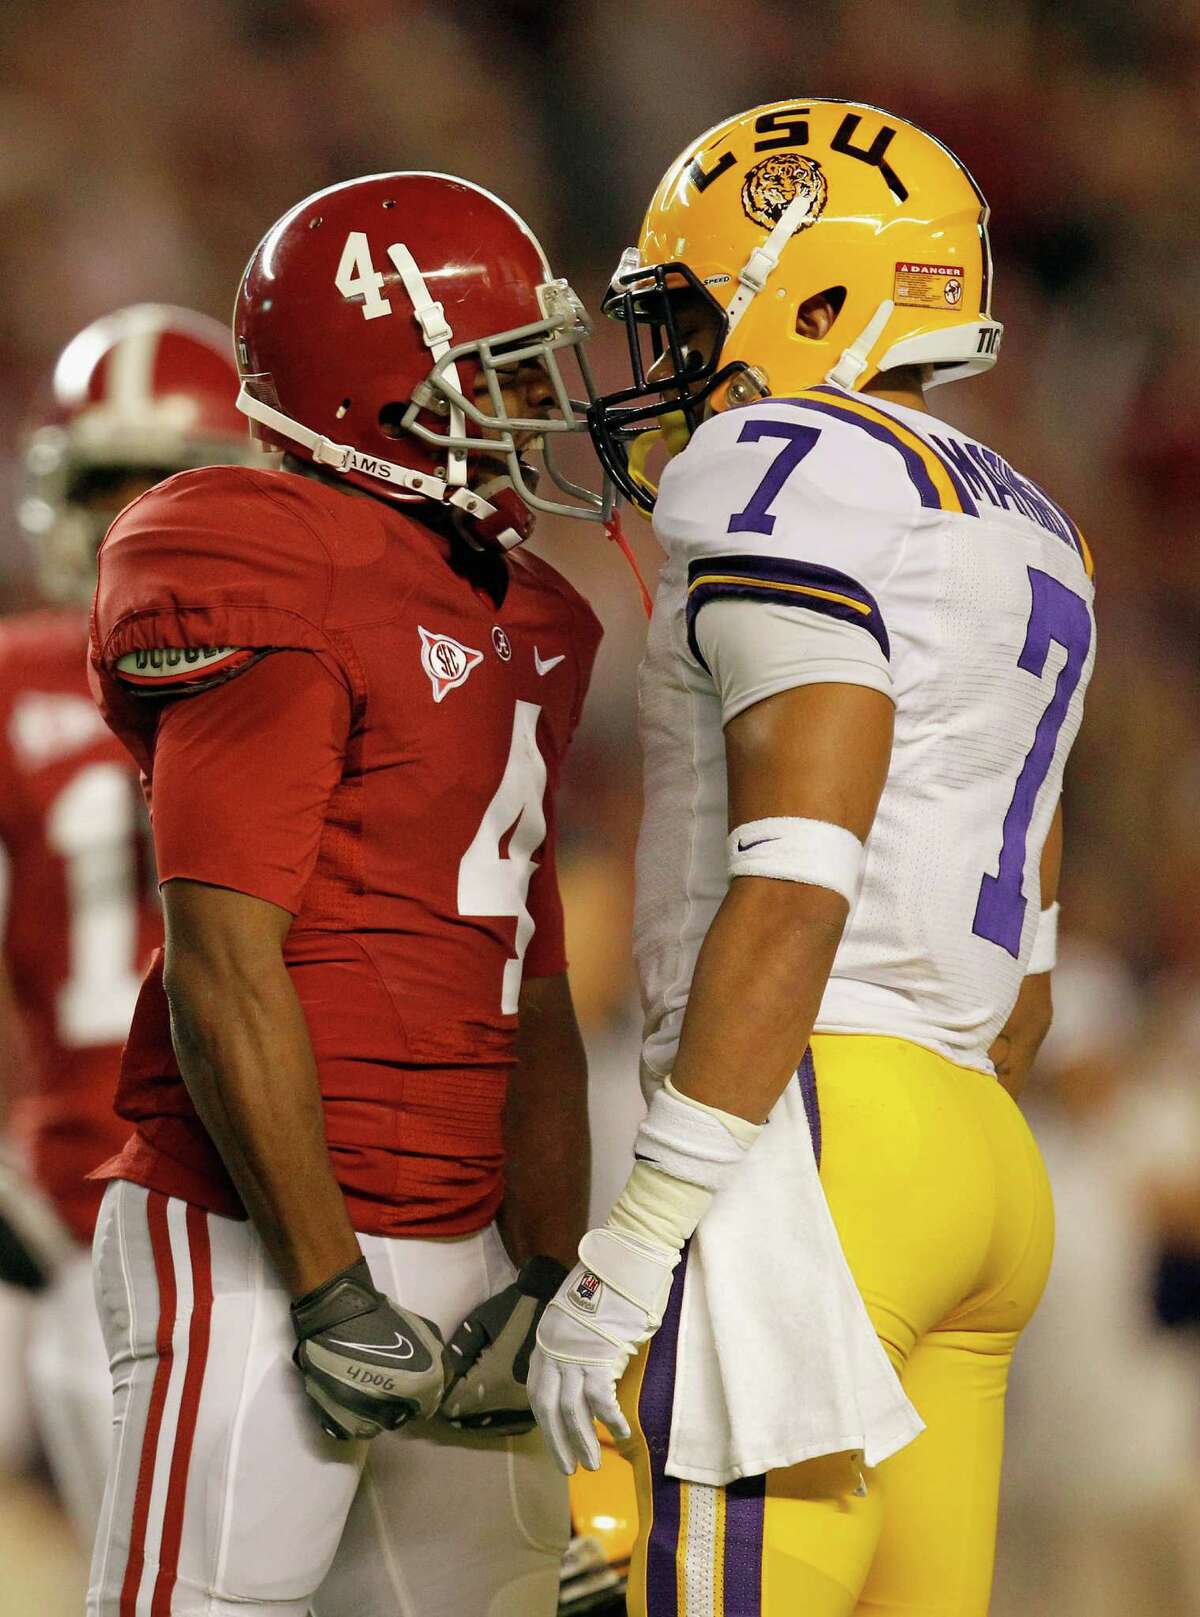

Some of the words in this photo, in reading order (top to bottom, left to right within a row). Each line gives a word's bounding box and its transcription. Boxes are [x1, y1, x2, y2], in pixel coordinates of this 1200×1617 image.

[687, 108, 910, 203] LSU
[334, 231, 393, 320] 4
[910, 265, 961, 277] DANGER
[727, 419, 822, 536] 7
[972, 565, 1092, 960] 7
[457, 699, 548, 1016] 4
